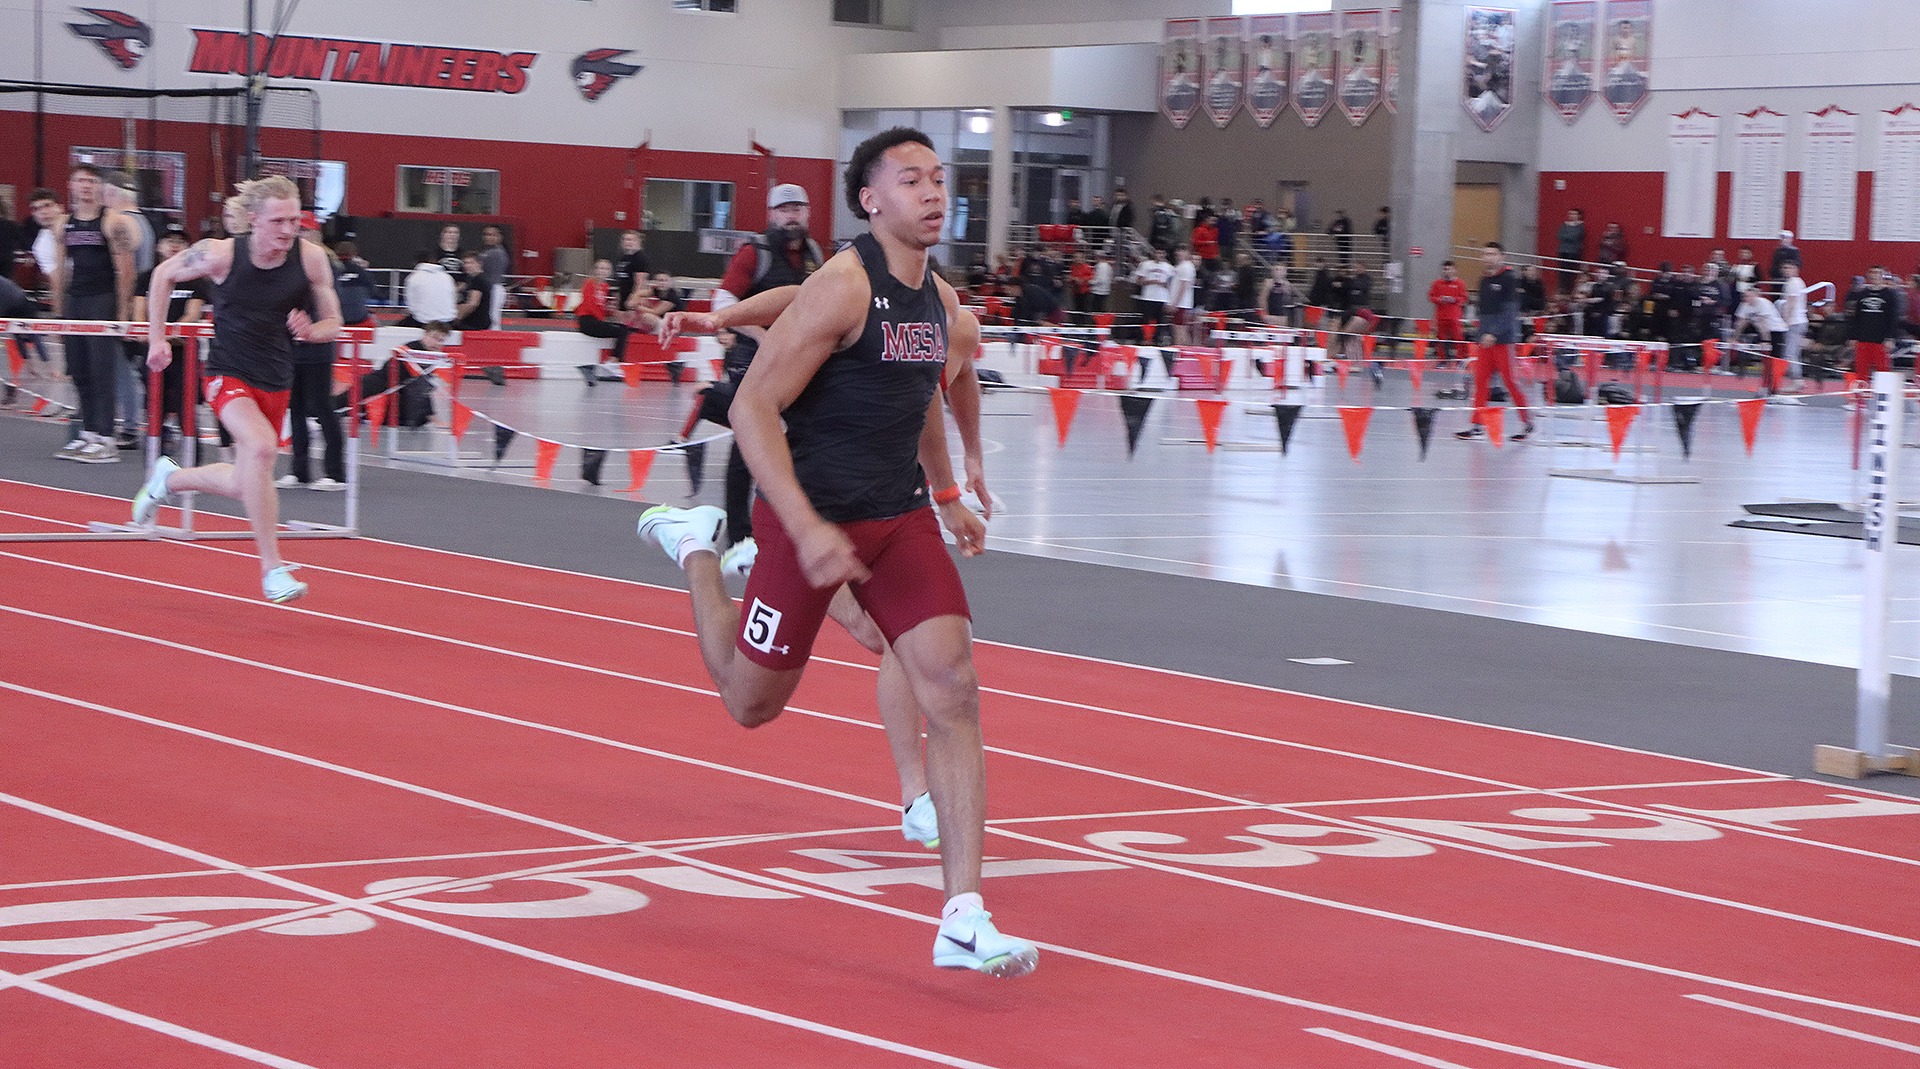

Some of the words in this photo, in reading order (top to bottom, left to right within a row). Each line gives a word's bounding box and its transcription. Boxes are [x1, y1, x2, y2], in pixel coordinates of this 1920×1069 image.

[189, 28, 540, 94] MOUNTAINEERS
[882, 321, 948, 362] MESA
[749, 605, 773, 644] 5
[1083, 824, 1437, 867] 3
[1350, 808, 1724, 850] 2
[363, 866, 804, 918] 5
